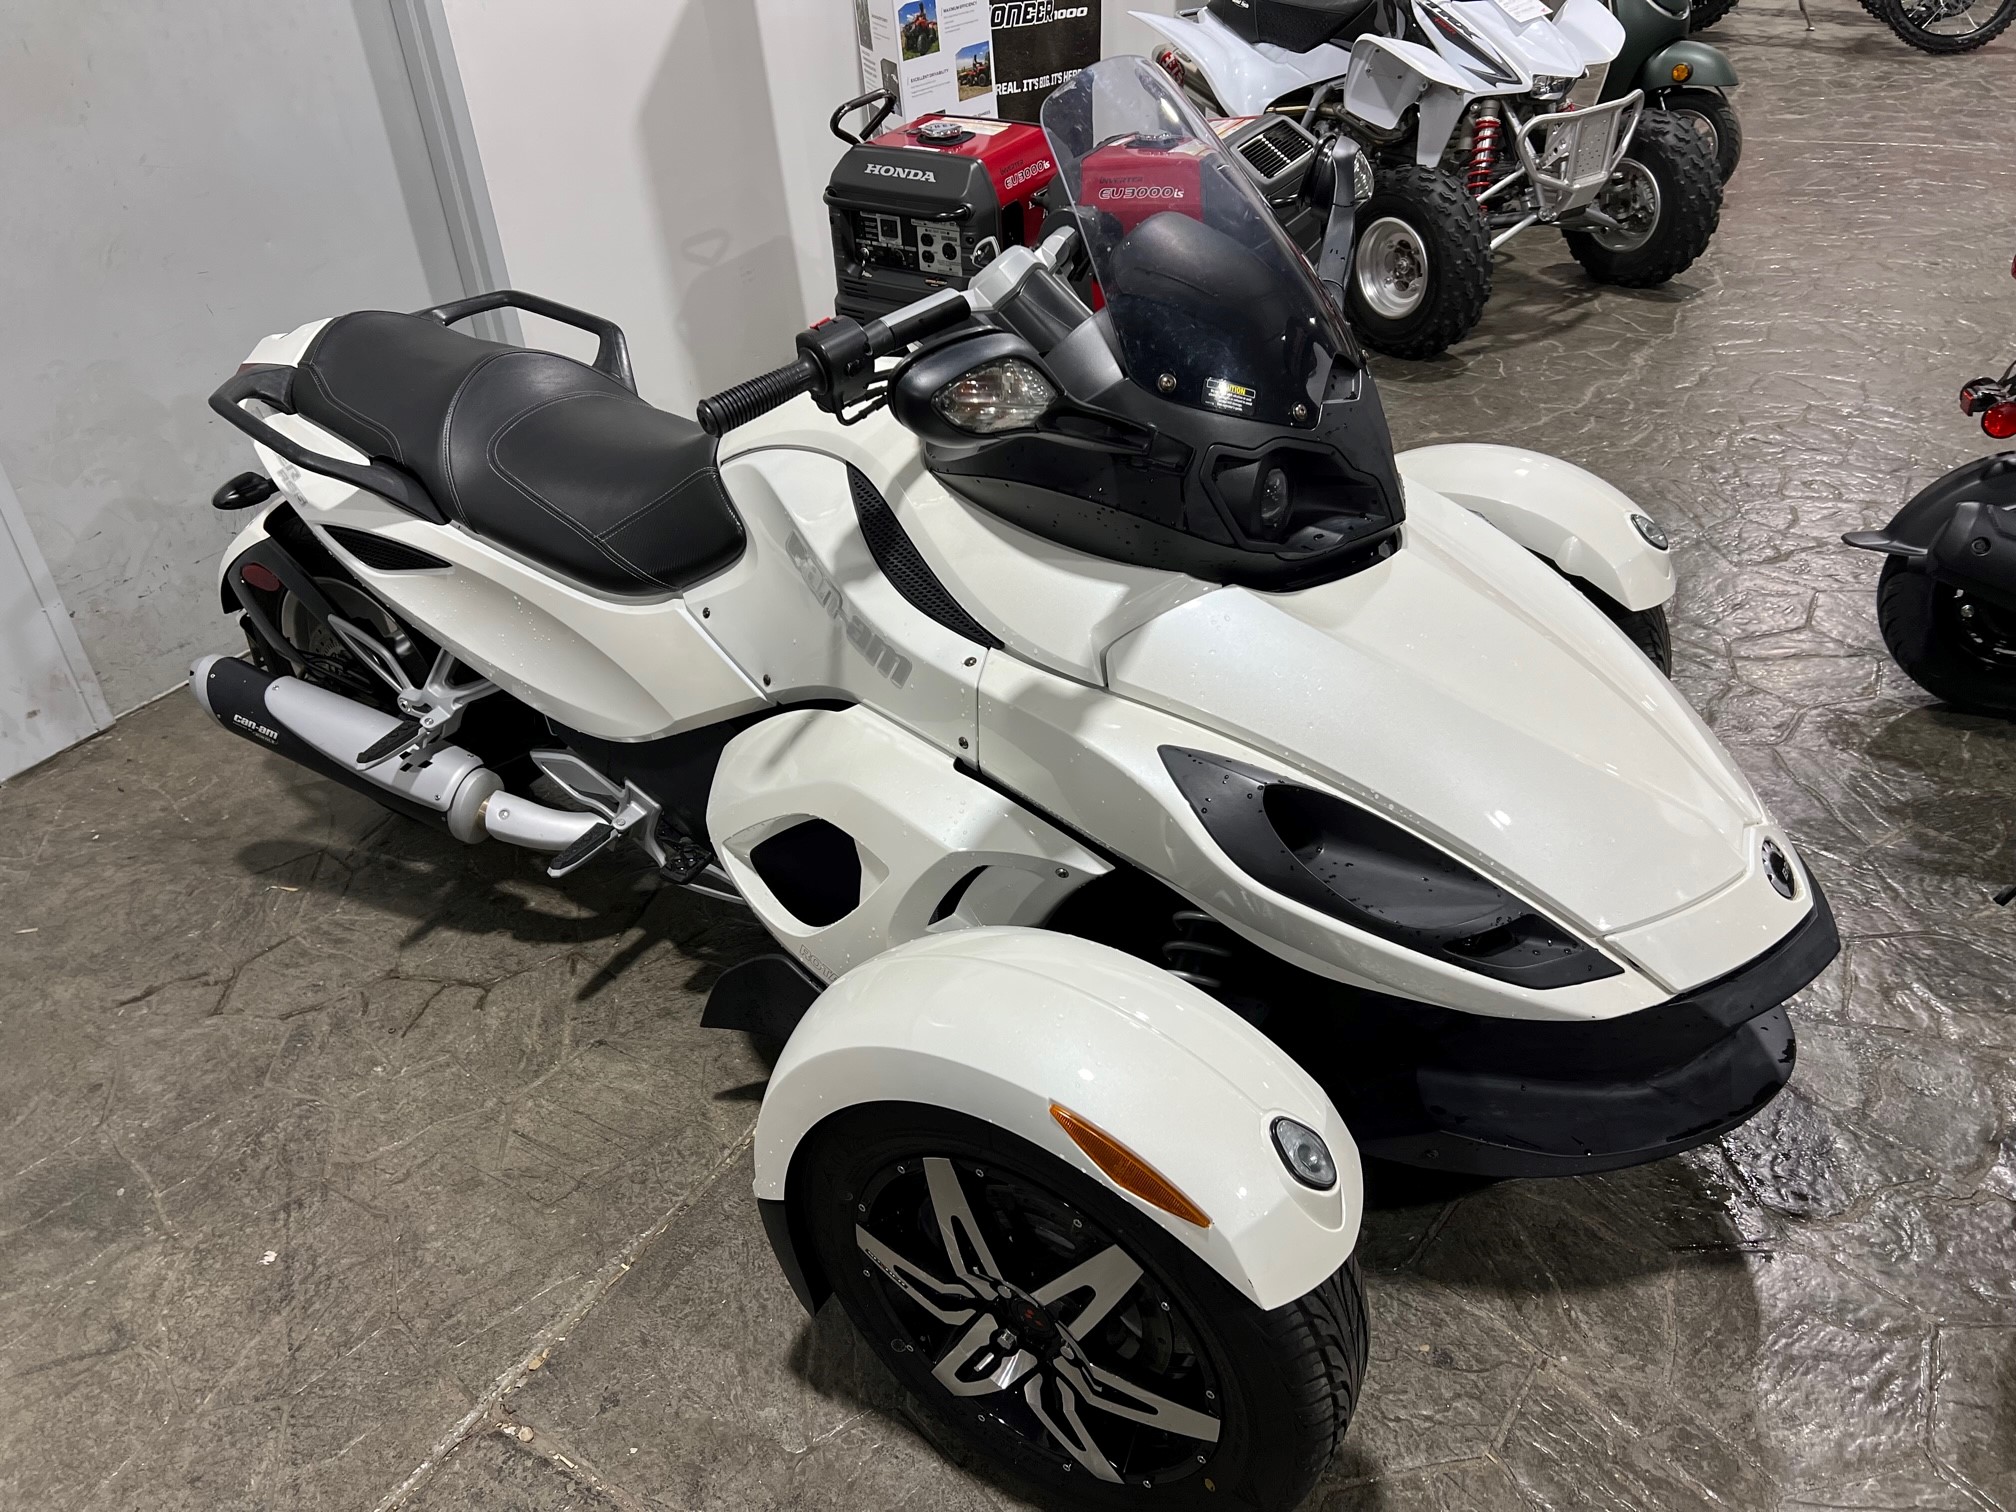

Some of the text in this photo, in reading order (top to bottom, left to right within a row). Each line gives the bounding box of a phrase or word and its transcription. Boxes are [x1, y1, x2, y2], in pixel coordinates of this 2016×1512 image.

[1054, 7, 1088, 20] 1000
[1022, 78, 1039, 92] IT'S
[1051, 70, 1063, 86] IT'S
[864, 163, 937, 183] HONDA
[1001, 159, 1025, 175] INVERTER
[1004, 159, 1051, 190] EU3000is
[1100, 175, 1143, 184] INVERTER
[1099, 186, 1185, 200] EU3000is
[233, 713, 279, 740] can-am
